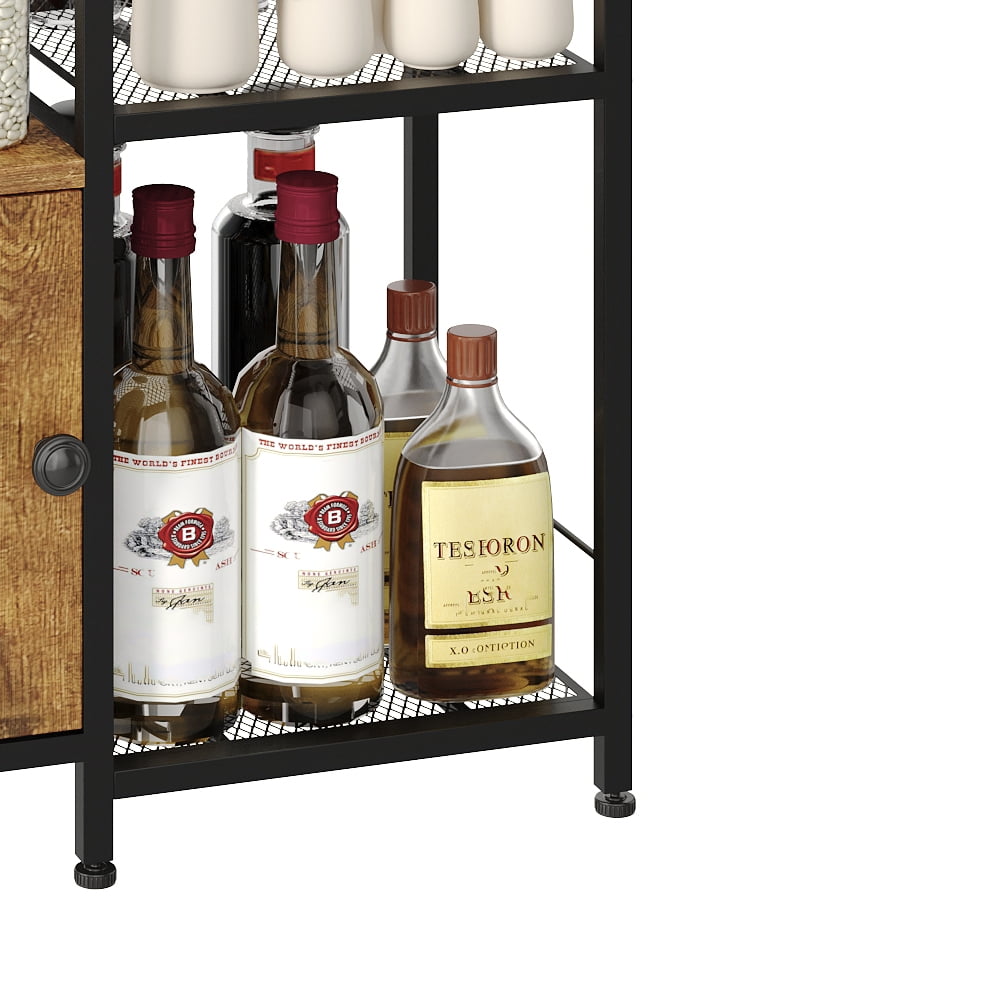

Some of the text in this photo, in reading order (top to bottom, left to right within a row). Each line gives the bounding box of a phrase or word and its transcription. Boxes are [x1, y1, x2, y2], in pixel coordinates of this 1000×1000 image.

[258, 438, 275, 448] THE
[278, 443, 324, 452] WORLD'S
[326, 439, 359, 451] FINEST
[132, 458, 178, 468] WORLD'S
[180, 456, 214, 467] FINEST
[327, 509, 342, 525] B
[181, 526, 197, 542] B
